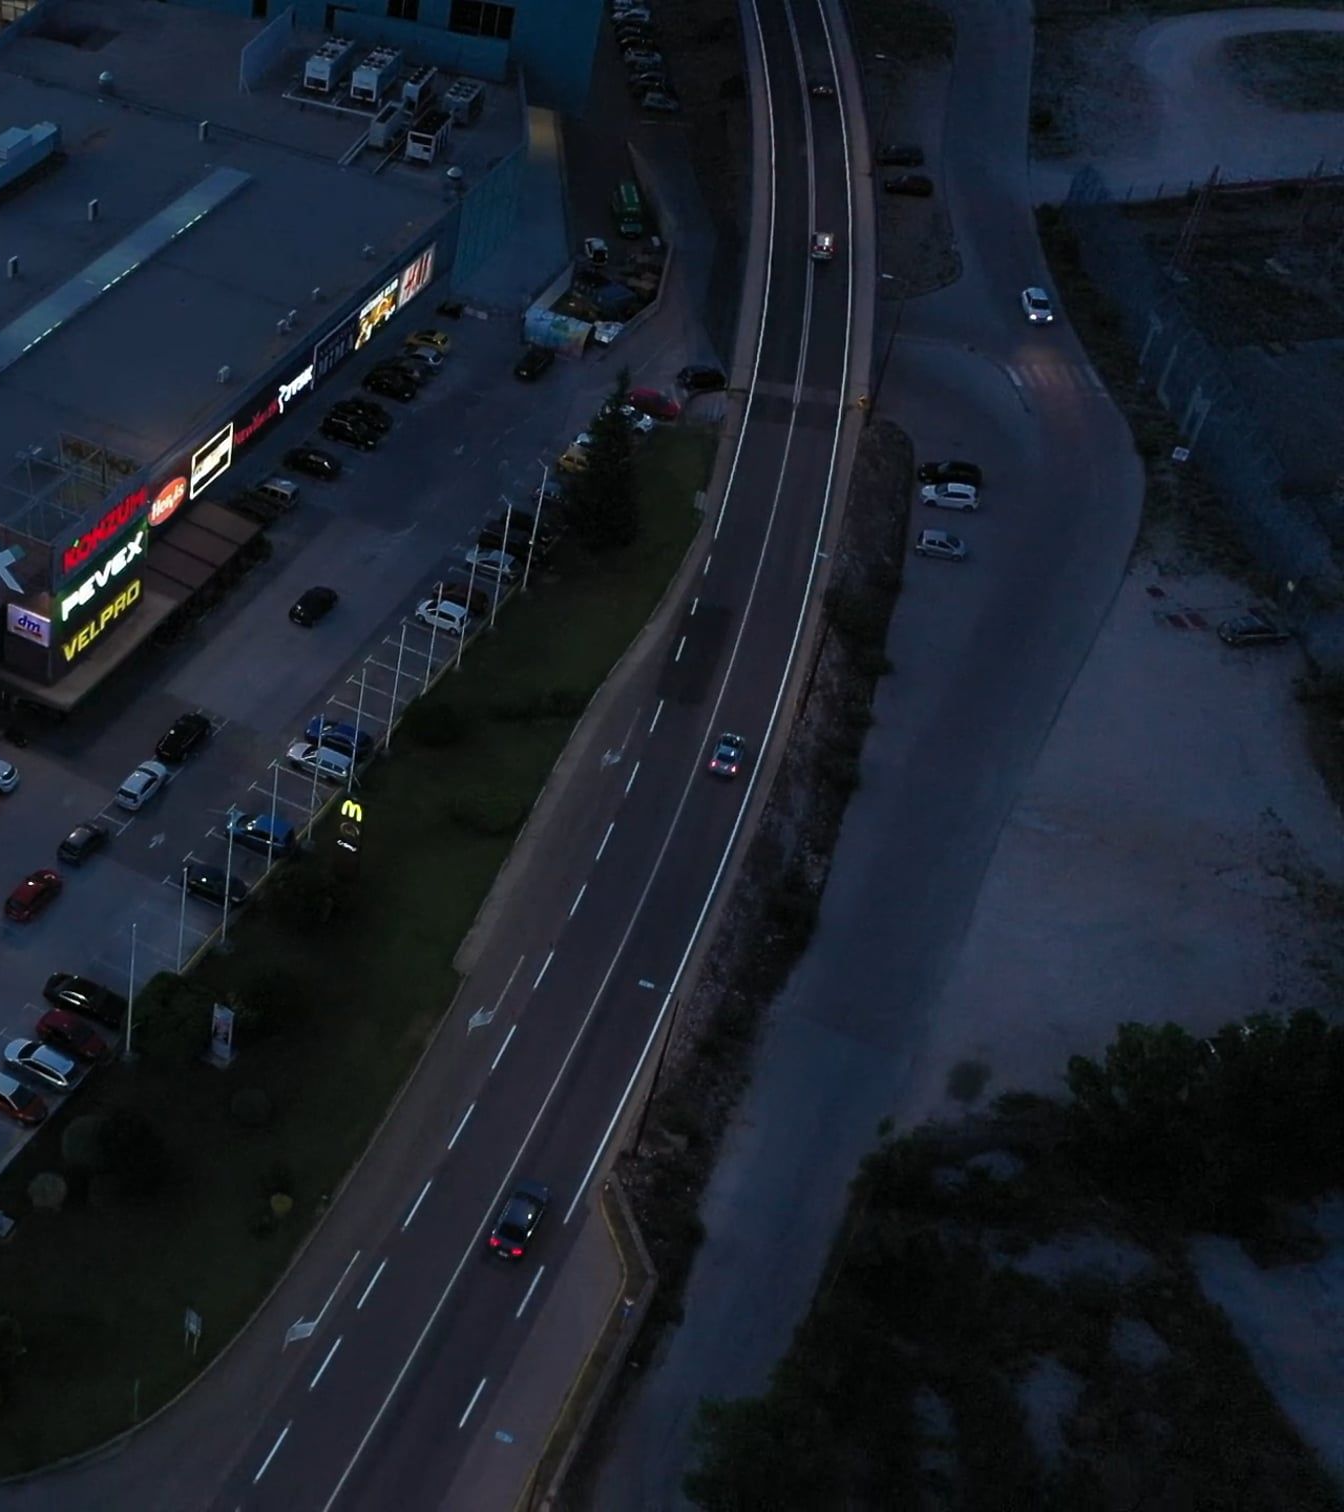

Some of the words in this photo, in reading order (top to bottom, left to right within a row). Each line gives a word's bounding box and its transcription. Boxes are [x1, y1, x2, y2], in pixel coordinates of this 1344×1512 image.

[62, 531, 143, 621] PEVEX
[18, 615, 40, 632] dm
[64, 580, 142, 661] VELPRO
